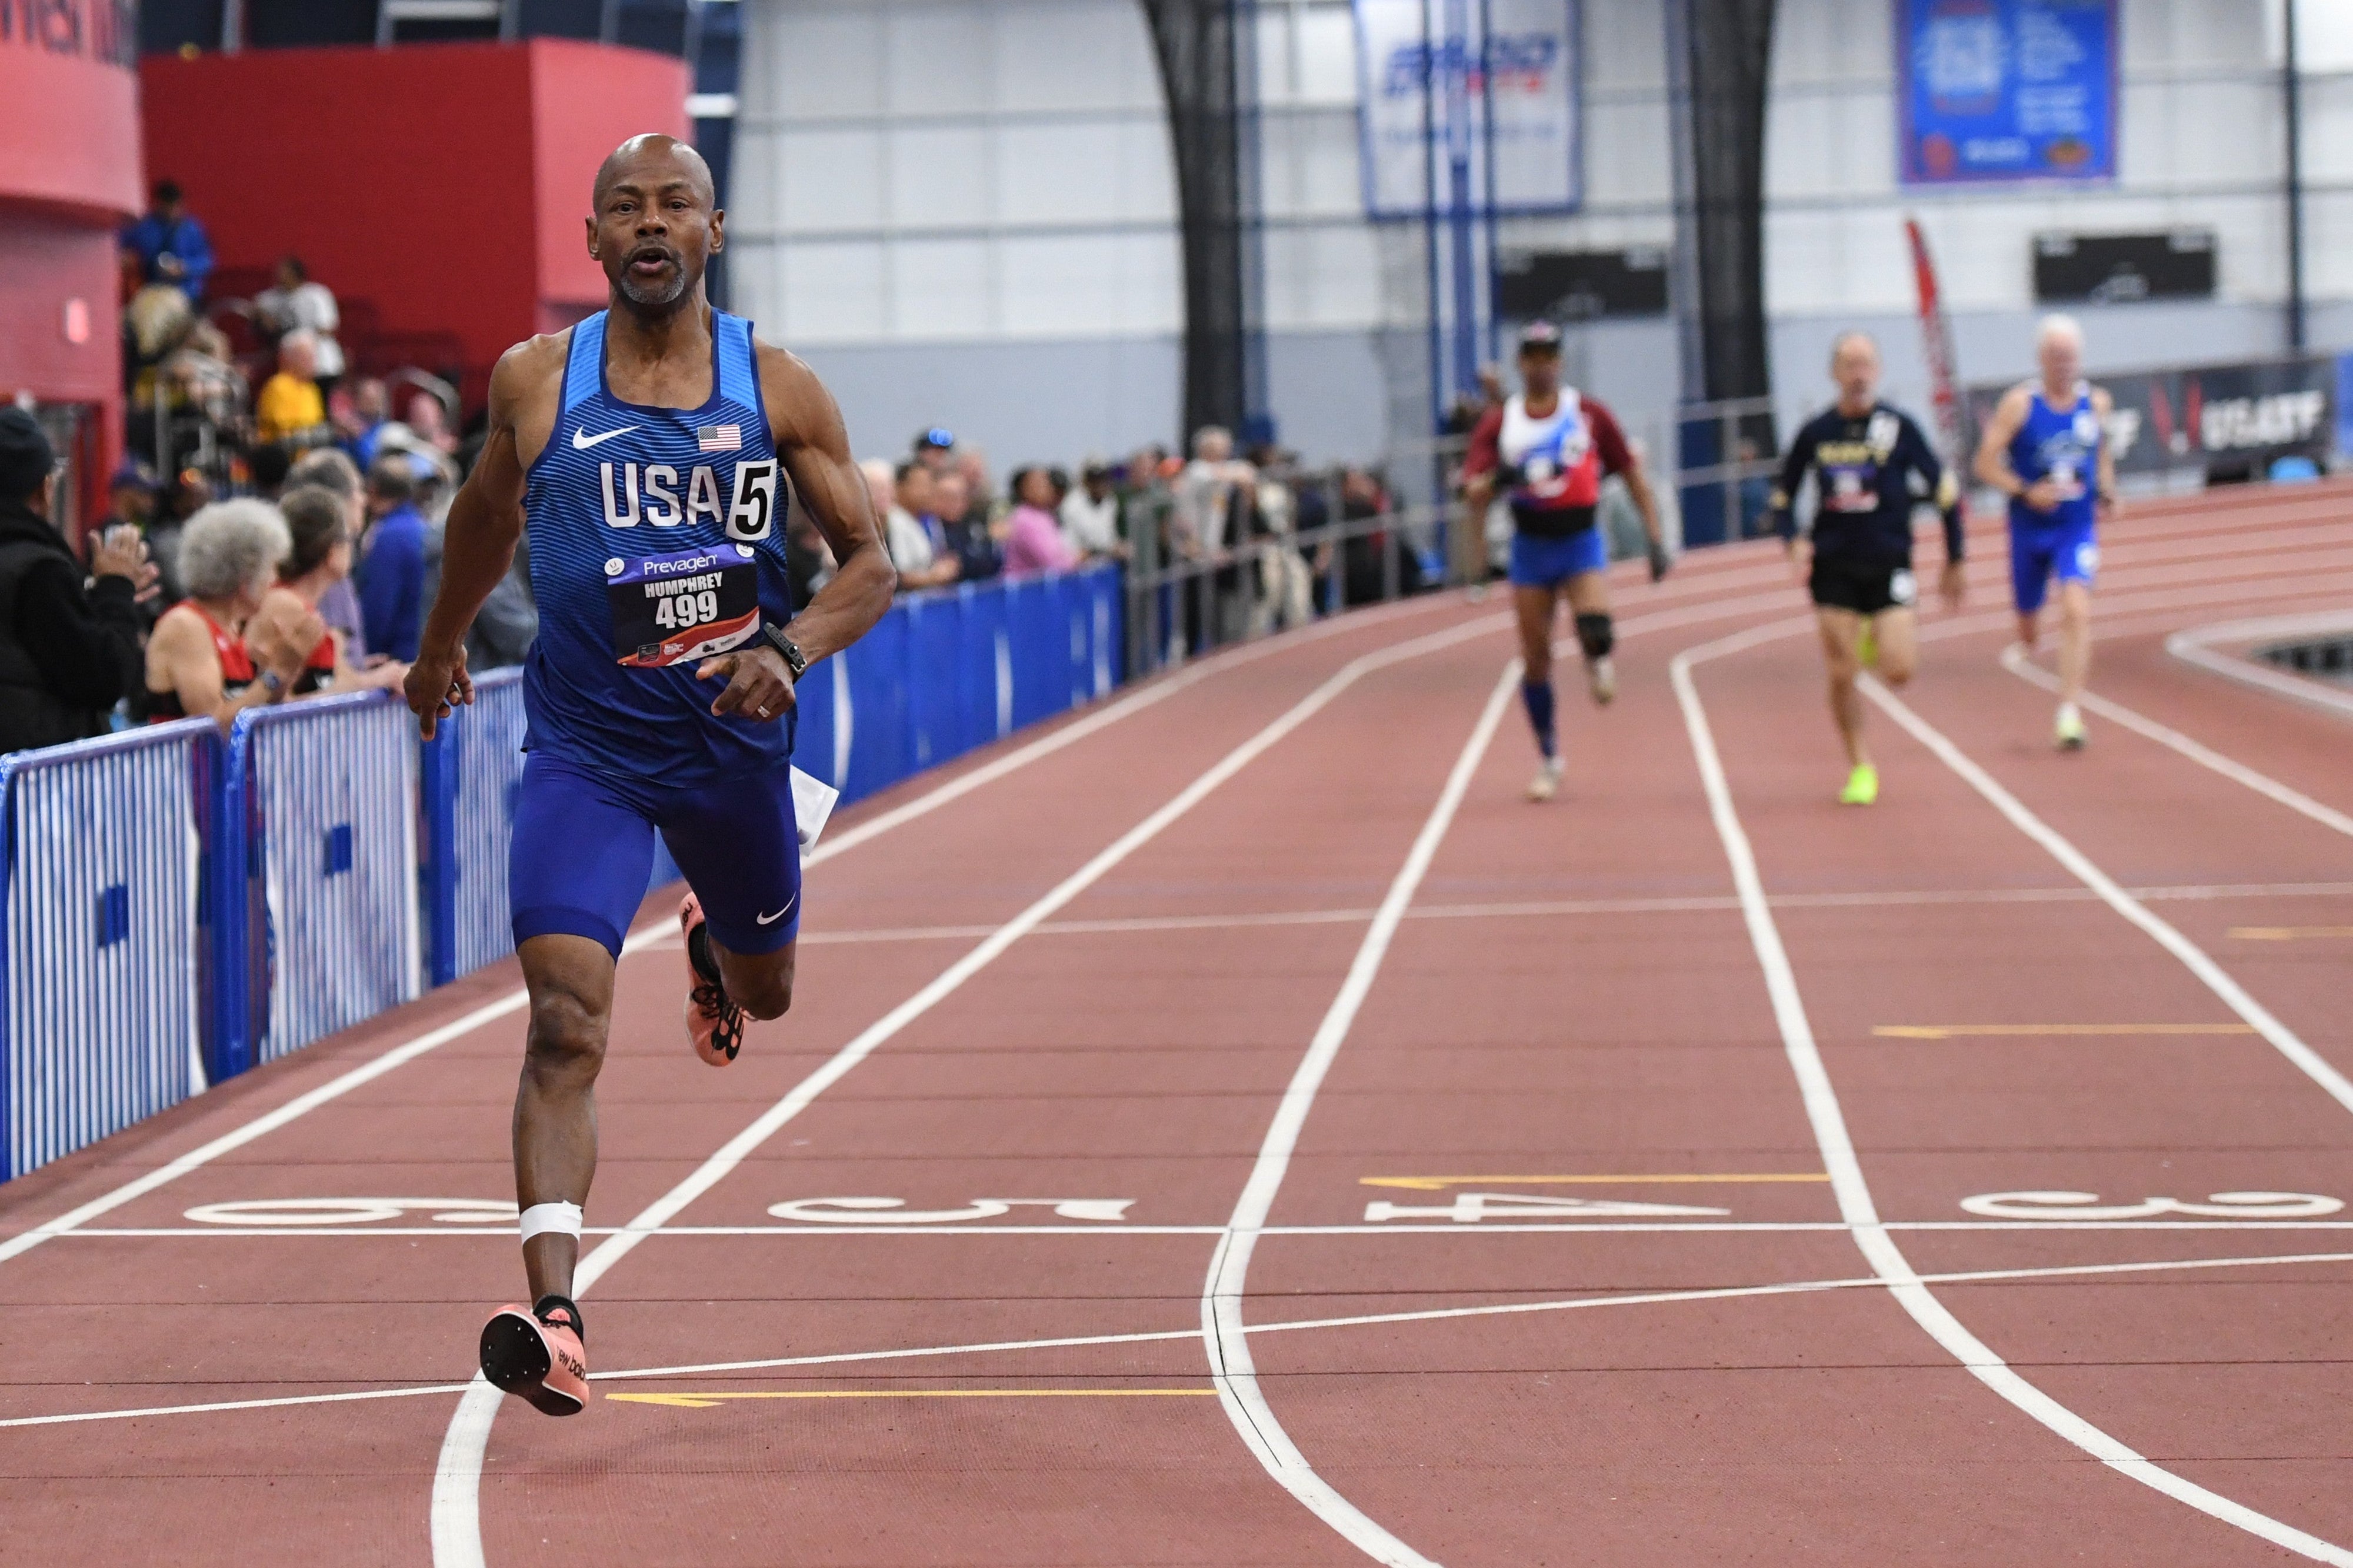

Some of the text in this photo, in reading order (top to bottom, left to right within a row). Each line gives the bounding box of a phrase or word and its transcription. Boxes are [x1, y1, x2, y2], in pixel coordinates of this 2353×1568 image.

[600, 462, 724, 528] USA
[735, 465, 772, 535] 5
[644, 555, 717, 576] Prevagen
[644, 572, 723, 598] HUMPHREY
[655, 590, 718, 629] 499
[767, 1196, 1137, 1223] 5
[1364, 1193, 1732, 1222] 4
[1959, 1190, 2346, 1220] 3
